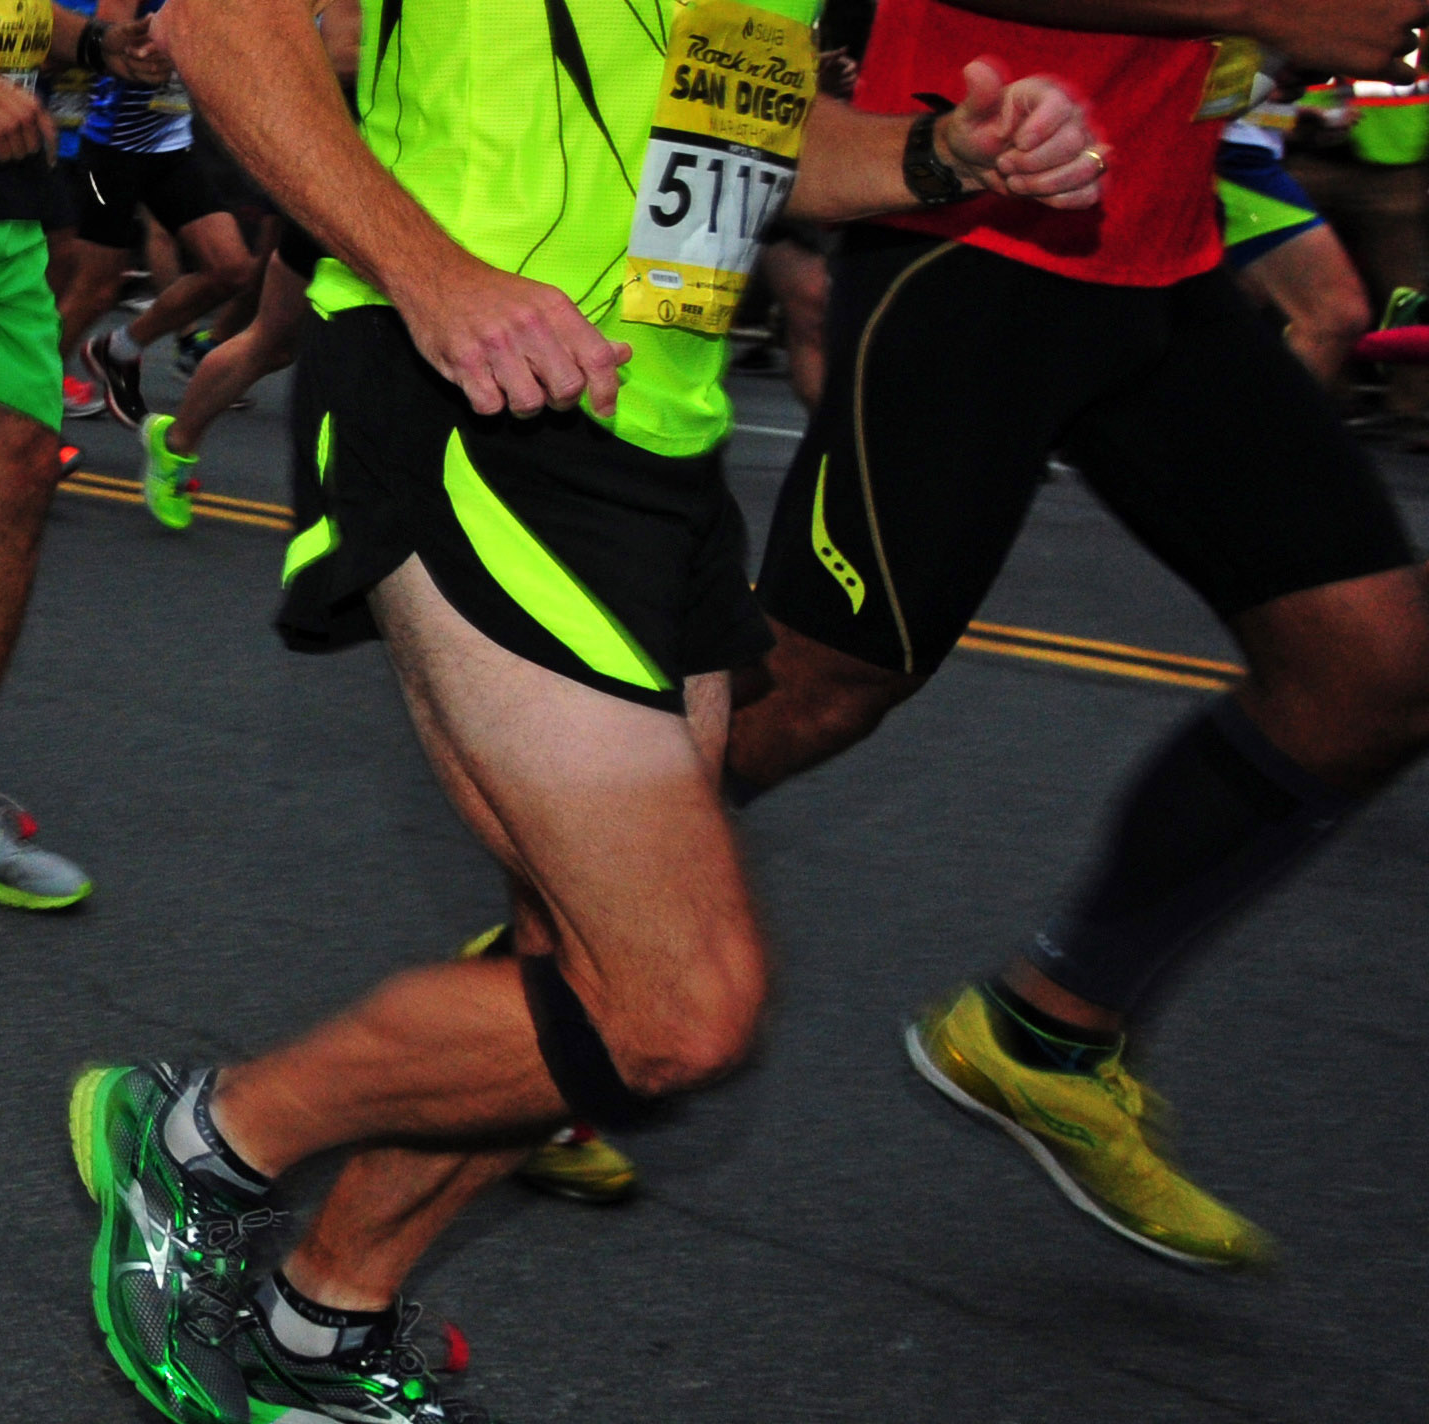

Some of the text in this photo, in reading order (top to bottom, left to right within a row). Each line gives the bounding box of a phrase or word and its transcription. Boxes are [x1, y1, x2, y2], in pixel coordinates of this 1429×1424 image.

[686, 34, 747, 73] Rock
[762, 56, 806, 89] Roll
[670, 64, 808, 130] SAN DIEGO
